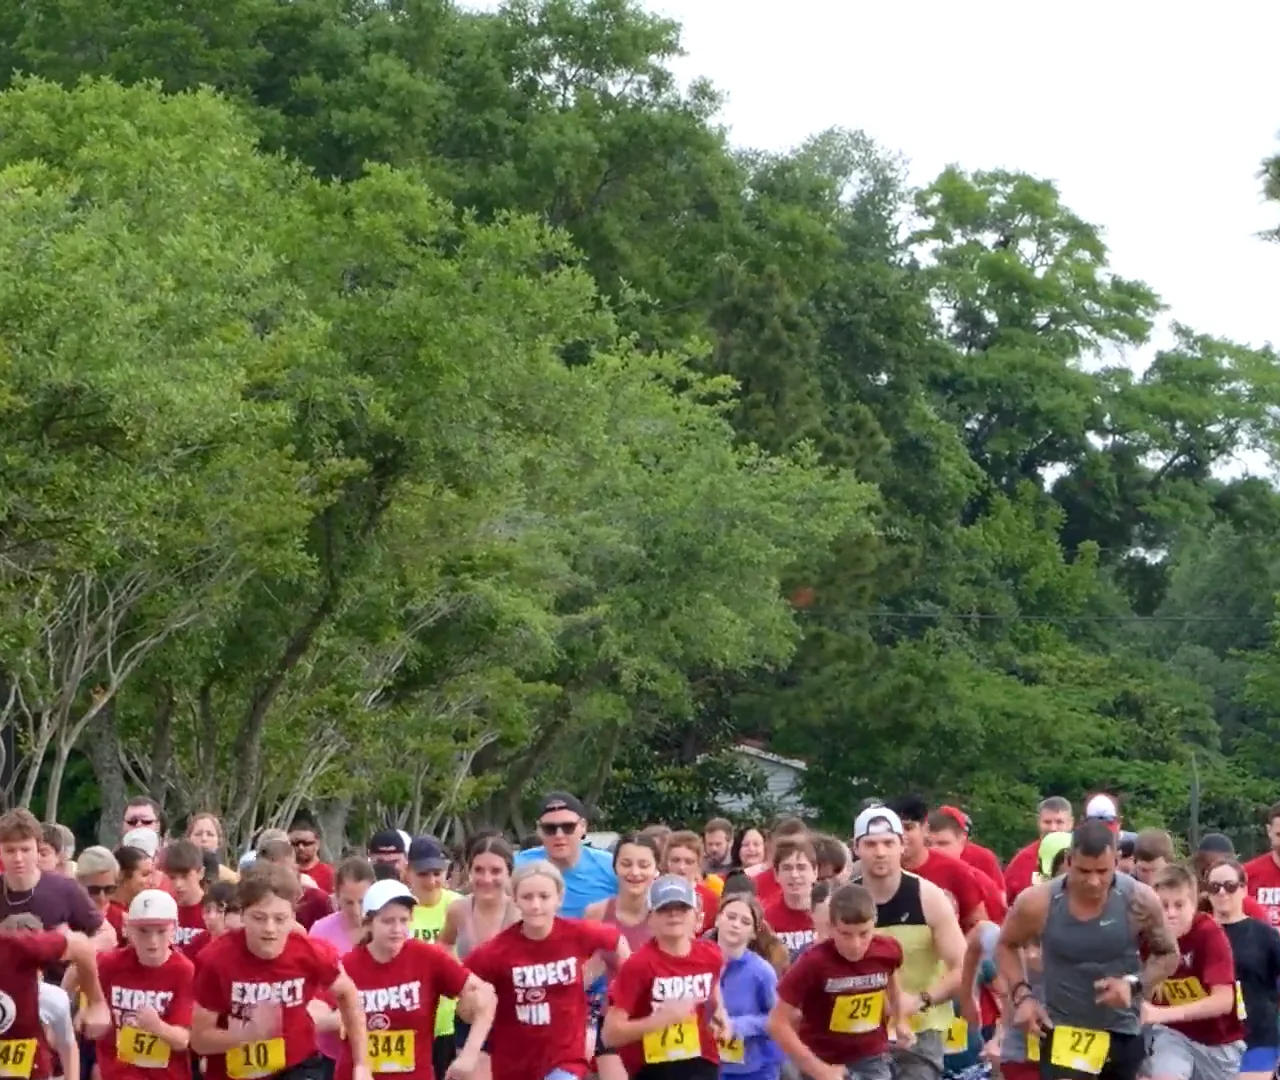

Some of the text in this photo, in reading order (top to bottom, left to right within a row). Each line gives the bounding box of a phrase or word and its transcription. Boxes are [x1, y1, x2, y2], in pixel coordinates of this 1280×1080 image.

[512, 956, 577, 987] EXPECT
[231, 977, 305, 1006] EXPECT
[652, 972, 714, 1002] EXPECT
[516, 1002, 552, 1026] WIN
[848, 997, 874, 1020] 25
[132, 1032, 159, 1056] 57
[368, 1034, 406, 1057] 344
[1071, 1030, 1096, 1054] 27
[242, 1042, 269, 1068] 10
